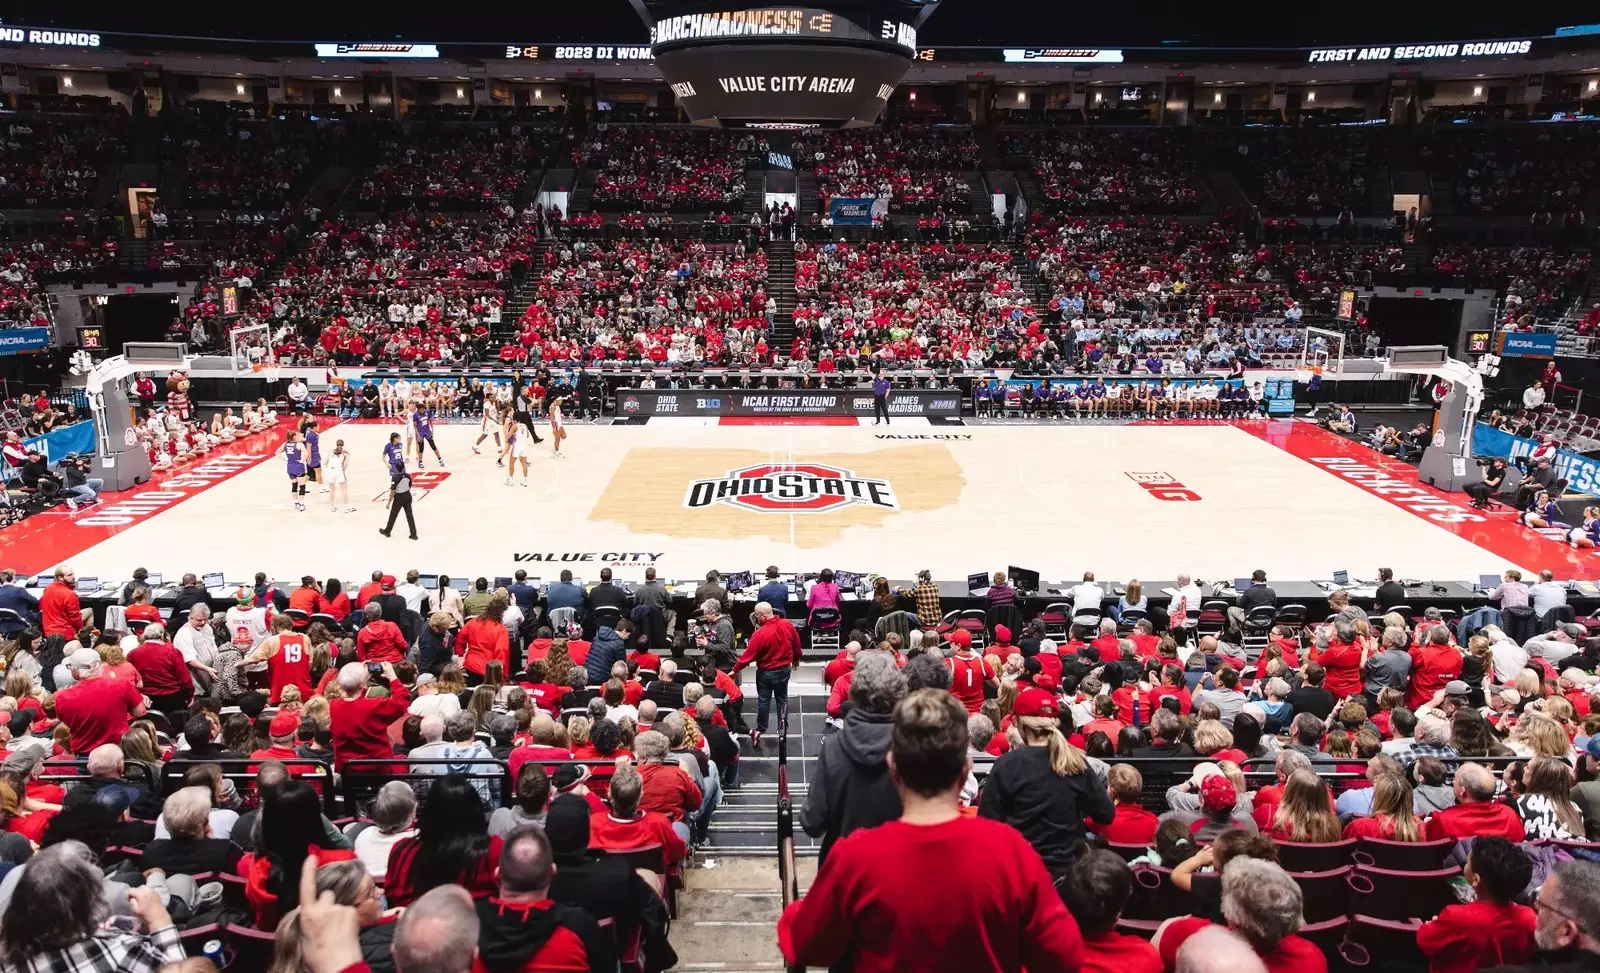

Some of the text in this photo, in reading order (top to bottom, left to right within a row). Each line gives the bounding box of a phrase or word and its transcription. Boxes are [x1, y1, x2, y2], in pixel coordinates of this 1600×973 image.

[29, 30, 100, 46] ROUNDS
[596, 47, 613, 58] DI
[1309, 41, 1532, 62] FIRST AND SECOND ROUNDS
[718, 76, 856, 93] VALUE CITY ARENA
[85, 337, 97, 346] 30
[1472, 341, 1484, 350] 30
[657, 395, 677, 404] OHIO
[742, 396, 837, 407] NCAA FIRST ROUND
[892, 396, 920, 405] JAMES
[929, 399, 957, 410] JMU
[655, 403, 679, 412] STATE
[887, 404, 924, 413] MADISON
[687, 474, 895, 508] OHIO STATE
[1309, 457, 1488, 523] BUCKEYES
[75, 491, 188, 526] OHIO
[513, 552, 665, 562] VALUE CITY
[284, 643, 302, 664] 19
[966, 668, 973, 687] 1
